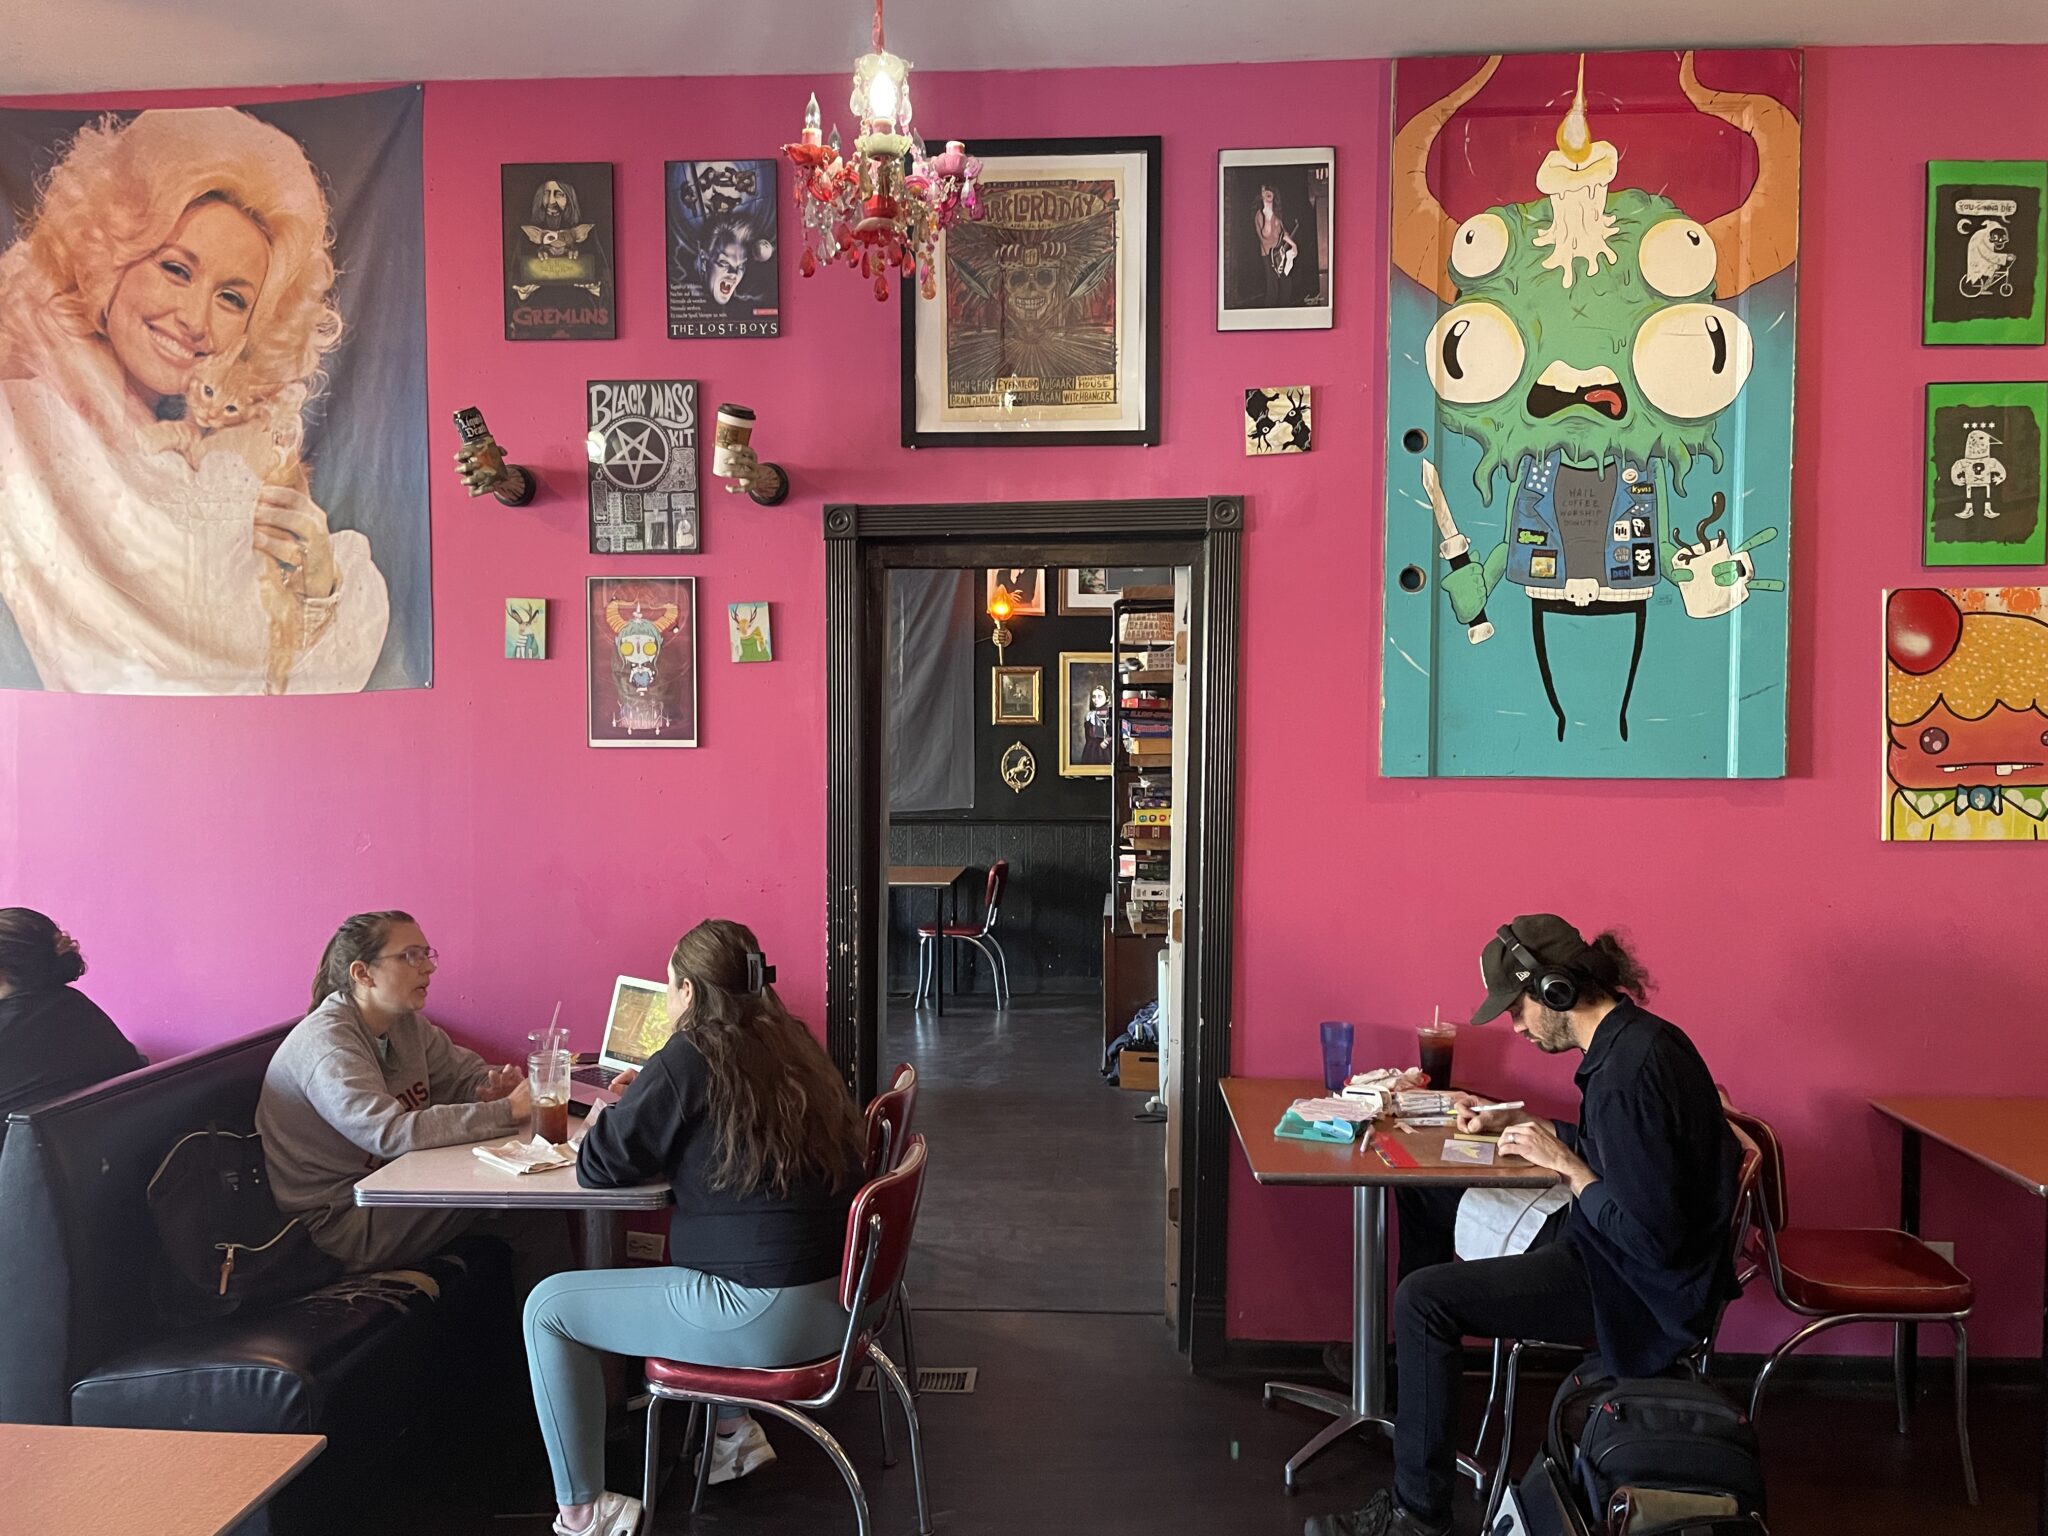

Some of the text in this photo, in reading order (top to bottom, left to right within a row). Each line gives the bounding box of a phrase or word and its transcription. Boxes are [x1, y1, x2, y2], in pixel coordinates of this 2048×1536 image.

[985, 190, 1096, 222] ARK LORD DAY
[512, 307, 609, 325] GREMLINS
[671, 323, 777, 336] THE LOST BOYS
[950, 380, 970, 393] HIGH
[1078, 380, 1108, 388] HOUSE
[1031, 391, 1061, 403] REAGAN
[589, 383, 694, 431] BLACK MASS
[668, 429, 694, 447] KIT
[1569, 488, 1595, 497] HAIL
[1562, 499, 1599, 507] COFFEE
[1560, 509, 1603, 518] WORSHIP
